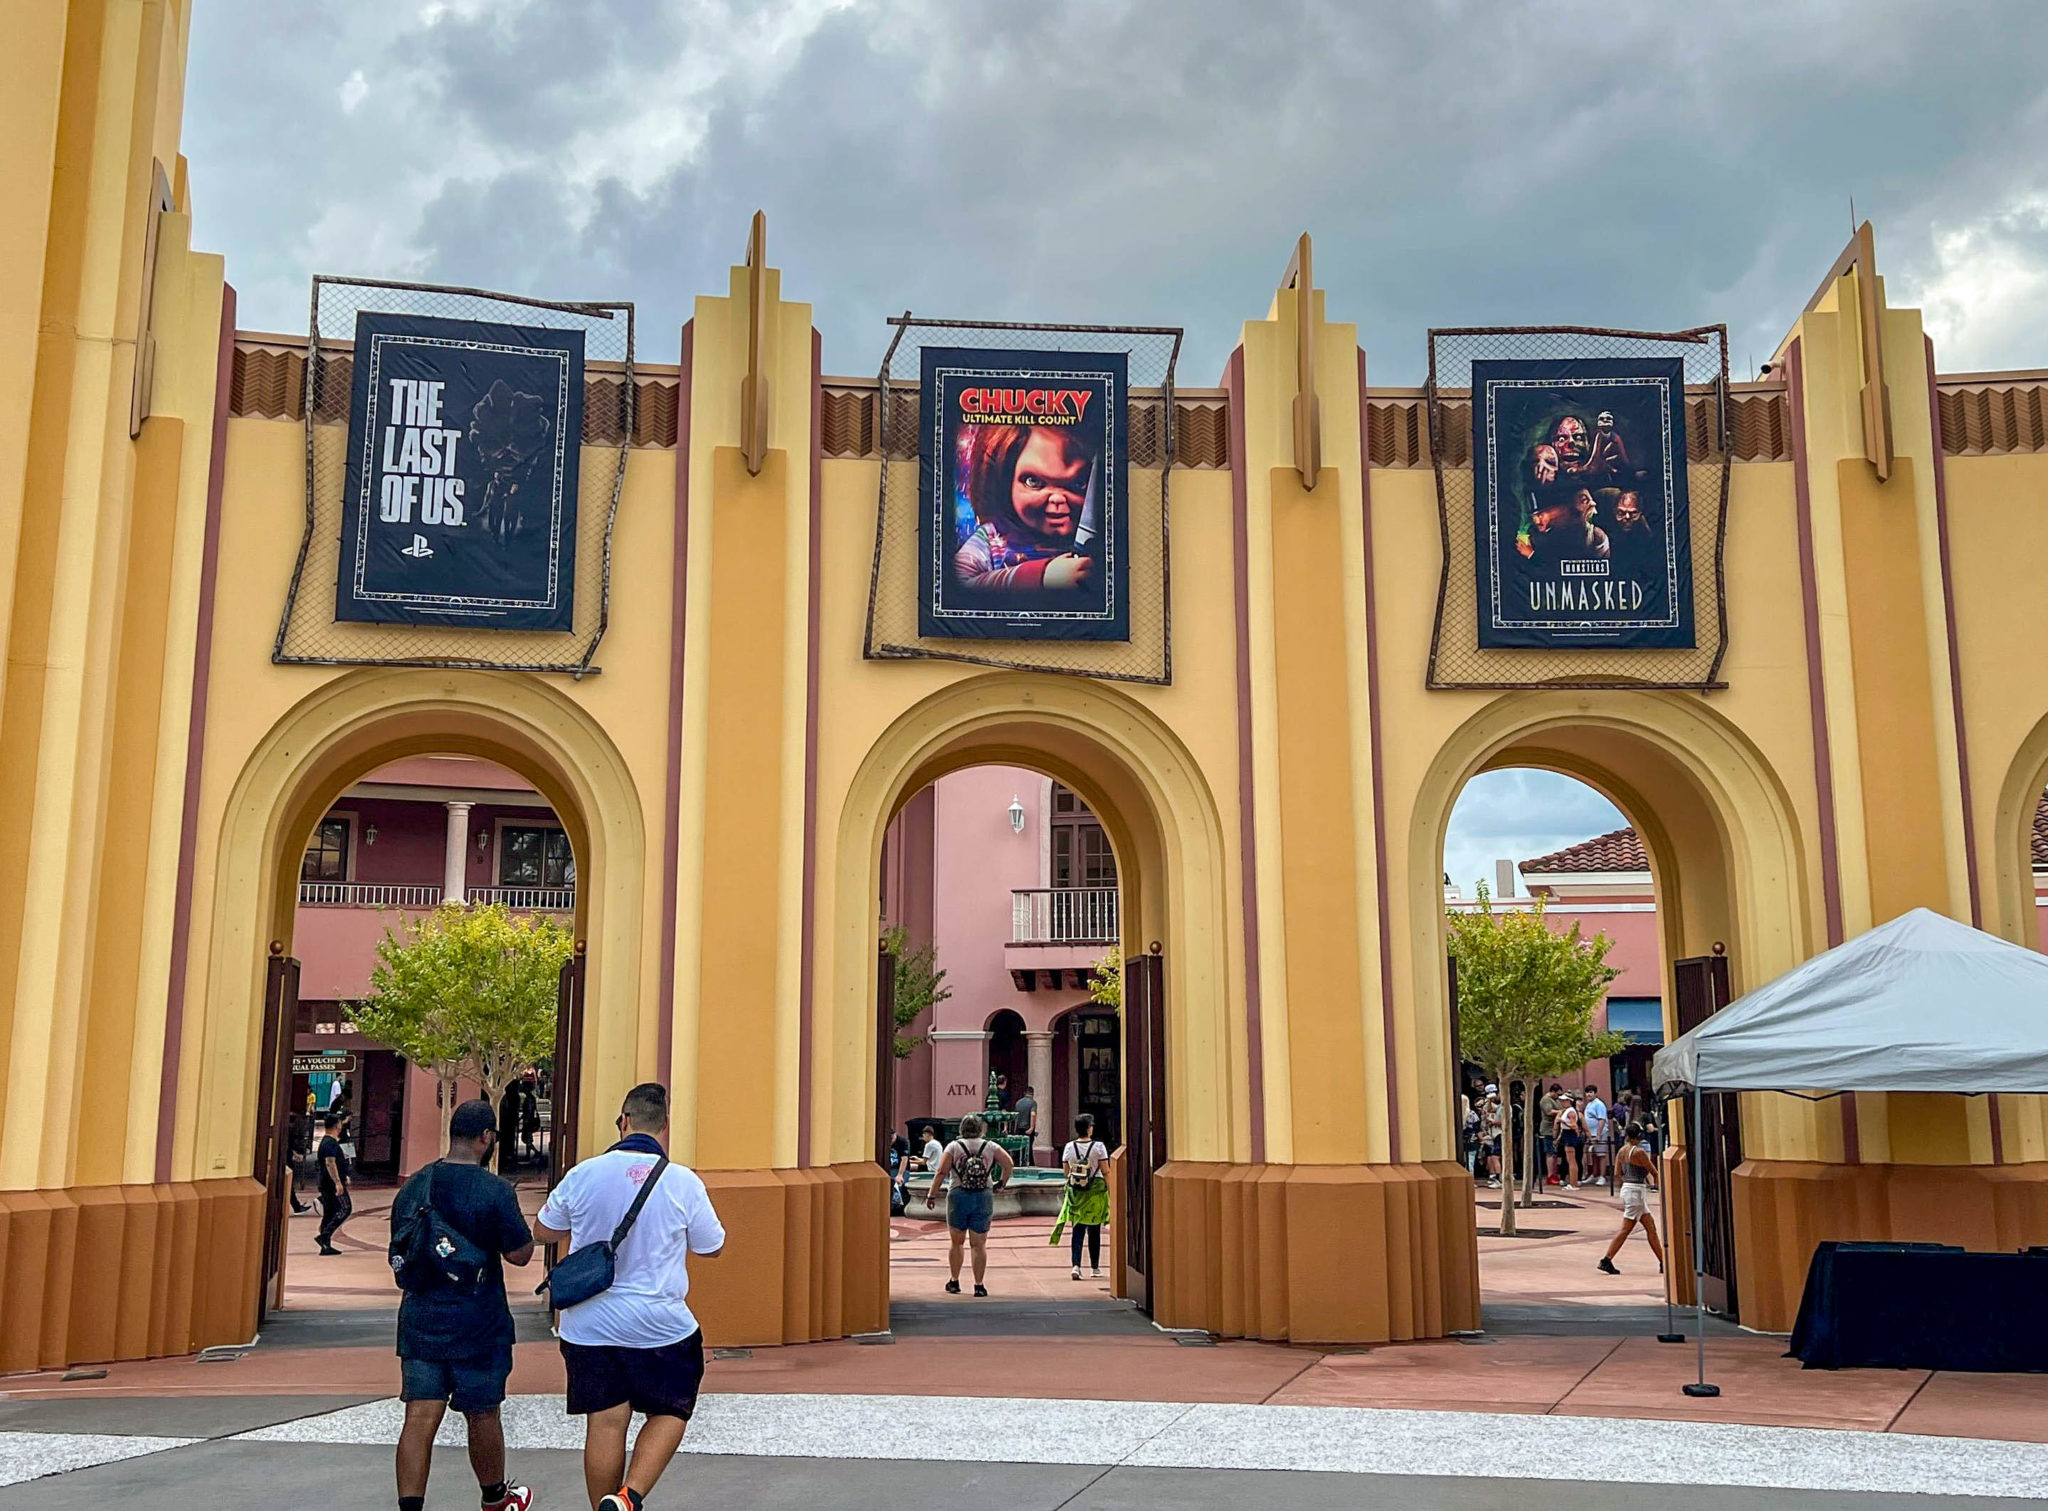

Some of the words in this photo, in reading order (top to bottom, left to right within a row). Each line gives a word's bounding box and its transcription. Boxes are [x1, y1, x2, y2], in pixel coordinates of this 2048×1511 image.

[389, 378, 446, 427] THE
[959, 387, 1093, 423] CHUCKY
[962, 413, 1013, 425] ULTIMATE
[1014, 414, 1035, 425] KILL
[1038, 415, 1077, 426] COUNT
[382, 426, 462, 477] LAST
[379, 474, 420, 523] OF
[421, 477, 465, 527] US
[1529, 579, 1643, 611] UNMASKED
[946, 1084, 977, 1096] ATM
